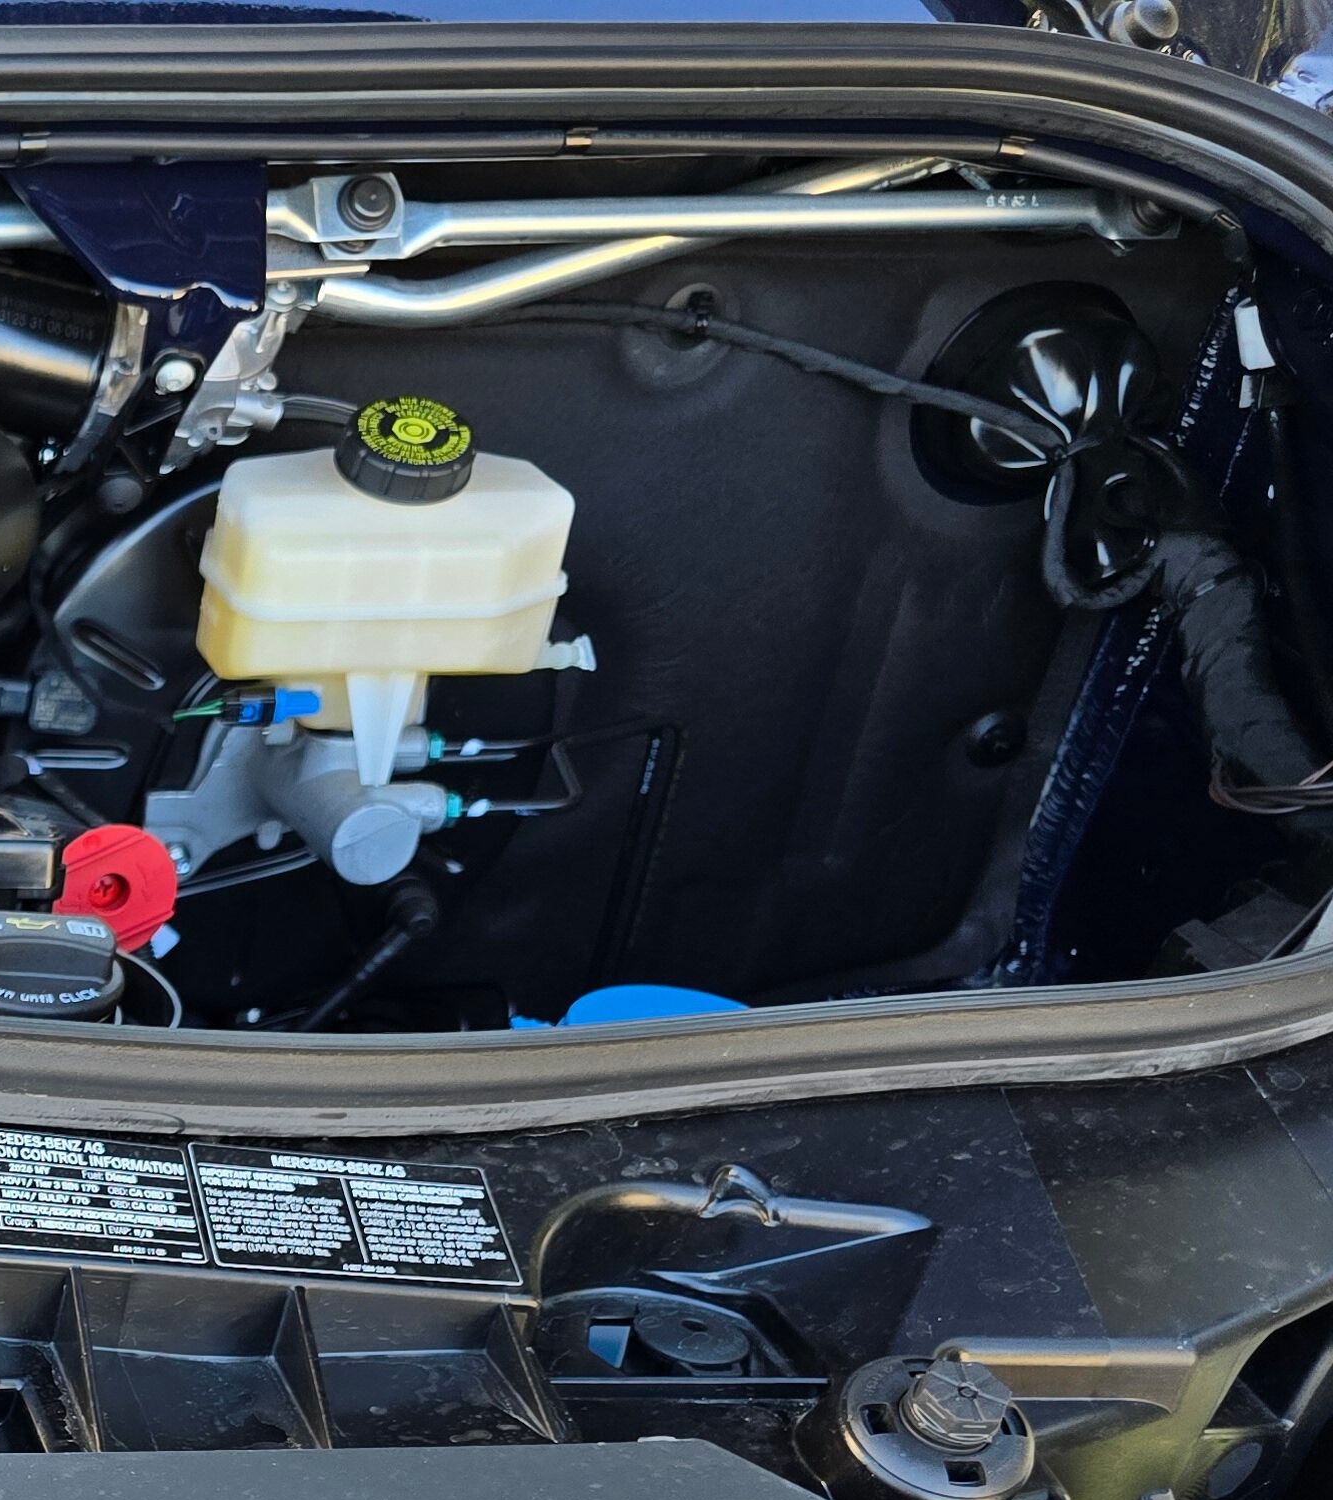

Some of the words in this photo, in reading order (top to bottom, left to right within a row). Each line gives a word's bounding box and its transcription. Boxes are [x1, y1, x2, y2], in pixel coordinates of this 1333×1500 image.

[58, 987, 101, 1004] CLICK
[81, 1140, 105, 1154] AG
[19, 1147, 87, 1165] CONTROL
[88, 1154, 185, 1175] INFORMATION
[269, 1154, 384, 1175] MERCEDES-BENZ
[382, 1164, 407, 1177] AG
